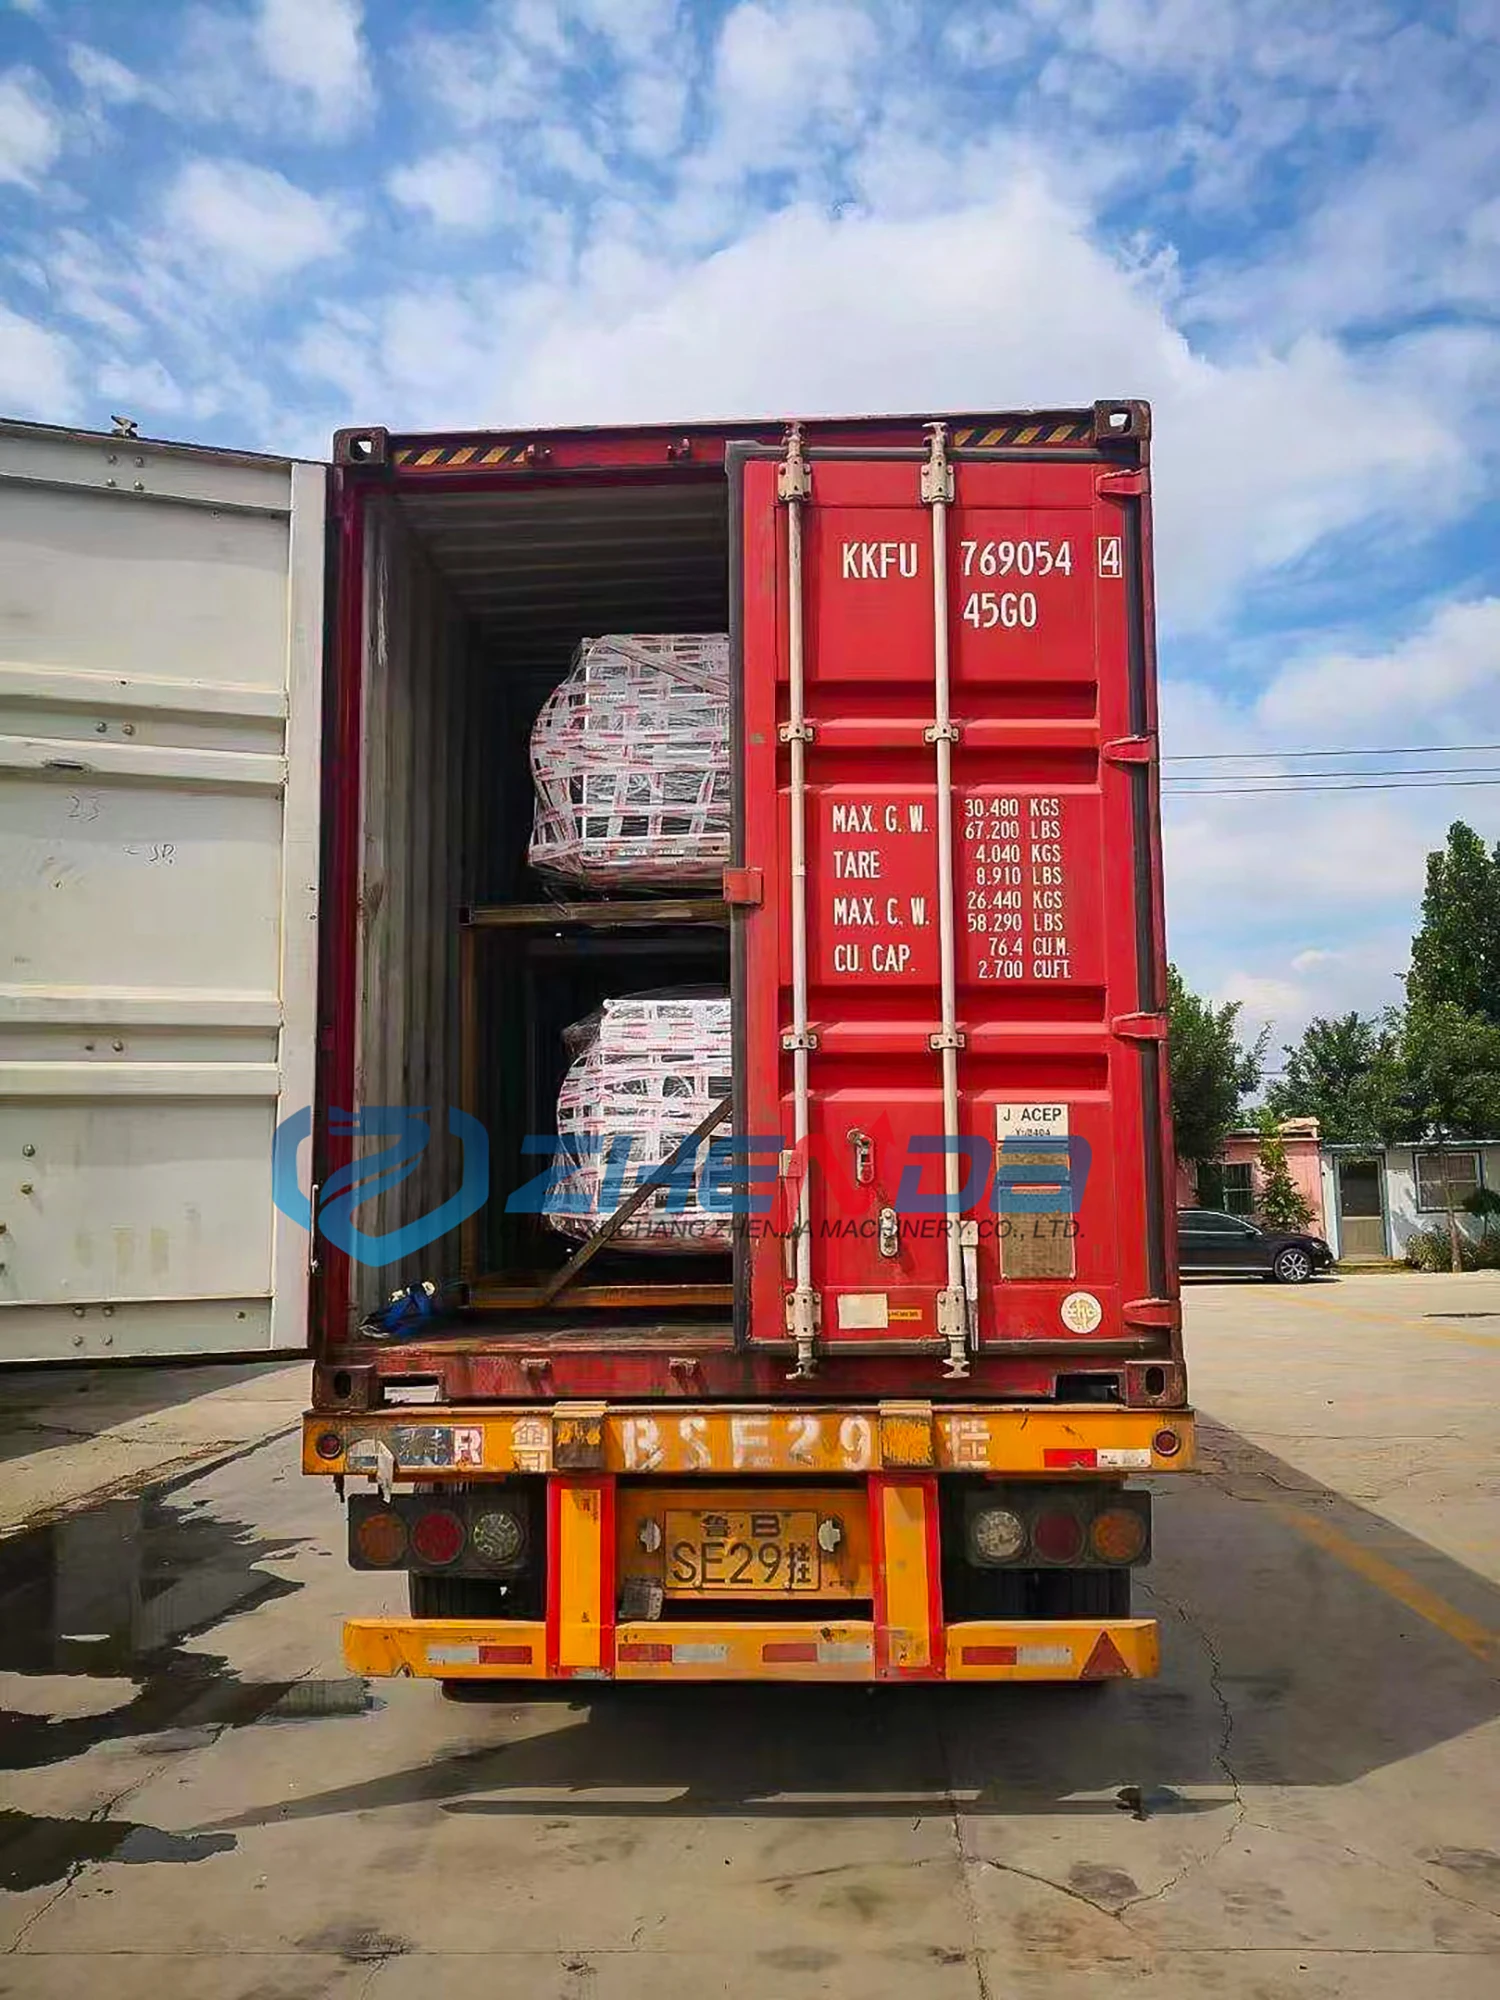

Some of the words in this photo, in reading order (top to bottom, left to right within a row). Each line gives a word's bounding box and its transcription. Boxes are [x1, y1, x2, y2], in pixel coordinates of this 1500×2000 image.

[842, 543, 918, 578] KKFU
[960, 541, 1072, 577] 769054
[1101, 540, 1121, 575] 4
[1030, 798, 1060, 817] KGS
[832, 804, 878, 833] MAX.
[1031, 820, 1061, 840] LBS
[1031, 844, 1061, 863] KGS
[833, 850, 881, 879] TARE
[1032, 866, 1063, 886] LBS
[1033, 890, 1063, 910] KGS
[833, 897, 879, 926] MAX.
[1033, 912, 1064, 933] LBS
[988, 937, 1024, 957] 76.4
[871, 944, 917, 972] CAP.
[1020, 1107, 1062, 1122] ACEP
